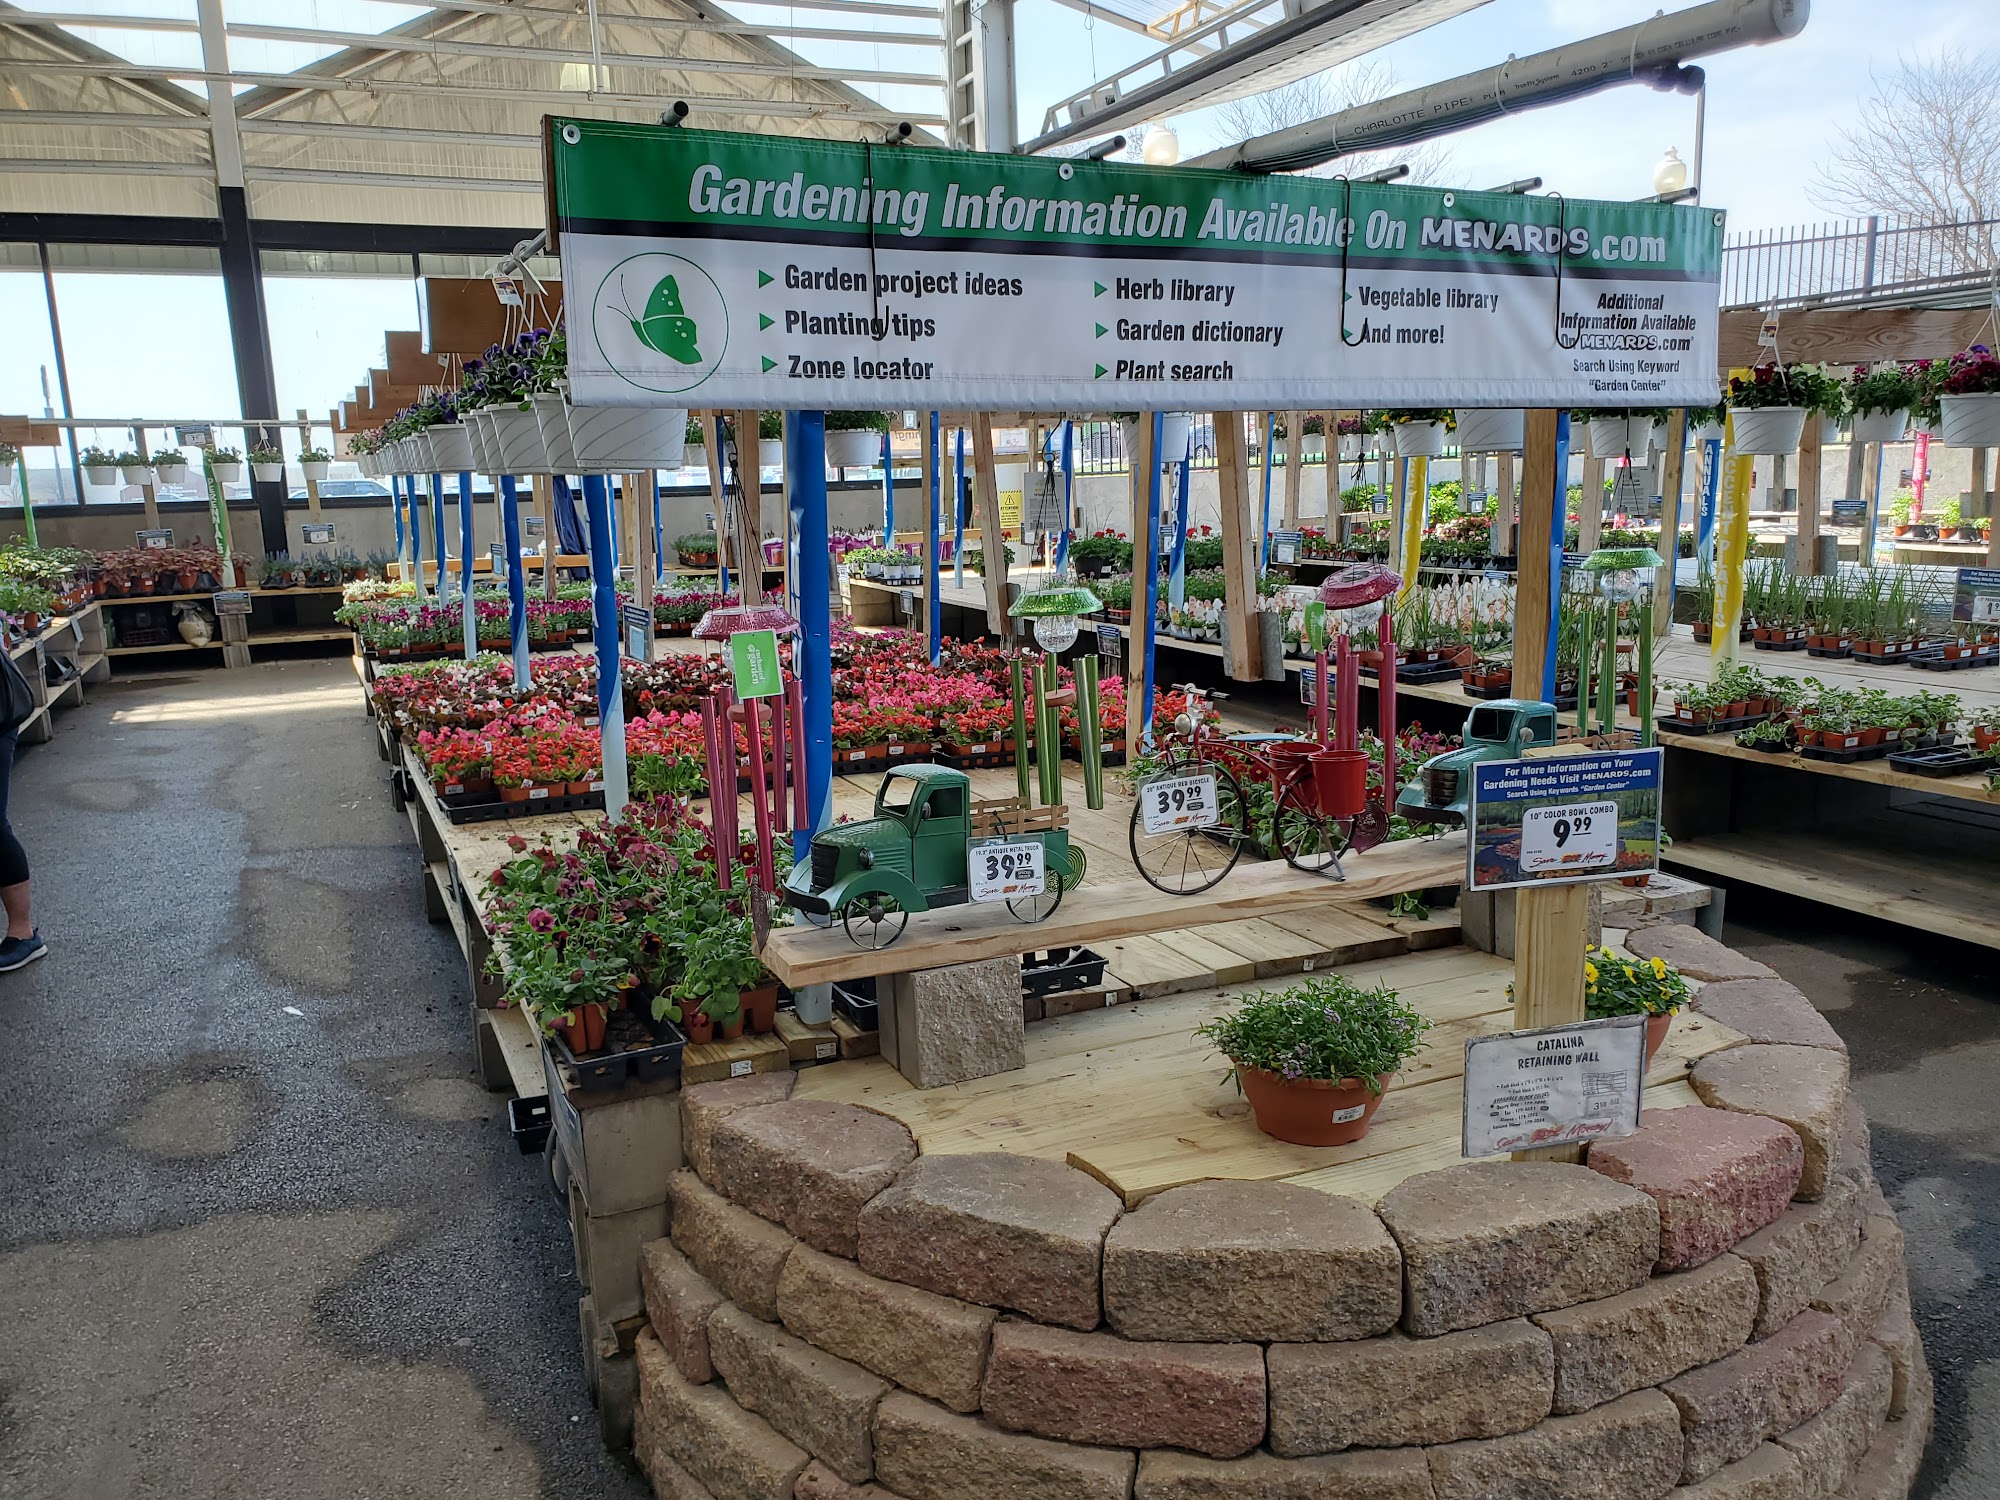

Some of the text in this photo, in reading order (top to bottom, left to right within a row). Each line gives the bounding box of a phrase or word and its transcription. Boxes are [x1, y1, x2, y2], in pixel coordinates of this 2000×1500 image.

[1354, 109, 1425, 135] CHARLOTTE
[1433, 97, 1469, 114] PIPE
[1571, 65, 1597, 77] 4200
[688, 164, 930, 237] Gardening
[941, 183, 1188, 239] Information
[1197, 198, 1356, 248] Available
[1365, 209, 1407, 250] On
[784, 264, 1023, 298] Garden project ideas
[1116, 277, 1235, 307] Herb library
[1358, 286, 1499, 313] Vegetable library
[1597, 293, 1664, 310] Additional
[785, 310, 936, 342] Planting tips
[1560, 312, 1696, 331] Information Available
[1116, 318, 1284, 347] Garden dictionary
[1362, 323, 1445, 344] And more!
[787, 355, 934, 380] Zone locator
[1115, 359, 1234, 381] Plant search
[1573, 358, 1680, 375] Search Using Keyword
[1701, 443, 1714, 517] ANNUALS
[207, 477, 225, 555] PERENNIALS
[1714, 444, 1738, 628] ACCENT PLANTS
[1505, 758, 1633, 777] For More Information on Your
[1155, 782, 1177, 791] ANTIQUE
[1189, 777, 1210, 786] BICYCLE
[1483, 769, 1652, 790] Gardening Needs Visit MENARDS.com
[1506, 790, 1529, 799] Search
[1529, 788, 1548, 797] Using
[1548, 785, 1579, 796] Keywords
[1543, 809, 1567, 819] COLOR
[1568, 807, 1588, 817] BOWL
[1589, 805, 1614, 815] COMBO
[988, 847, 1009, 855] ANTIQUE
[1536, 1035, 1585, 1052] CATALINA
[1517, 1052, 1600, 1070] RETAINING WALL
